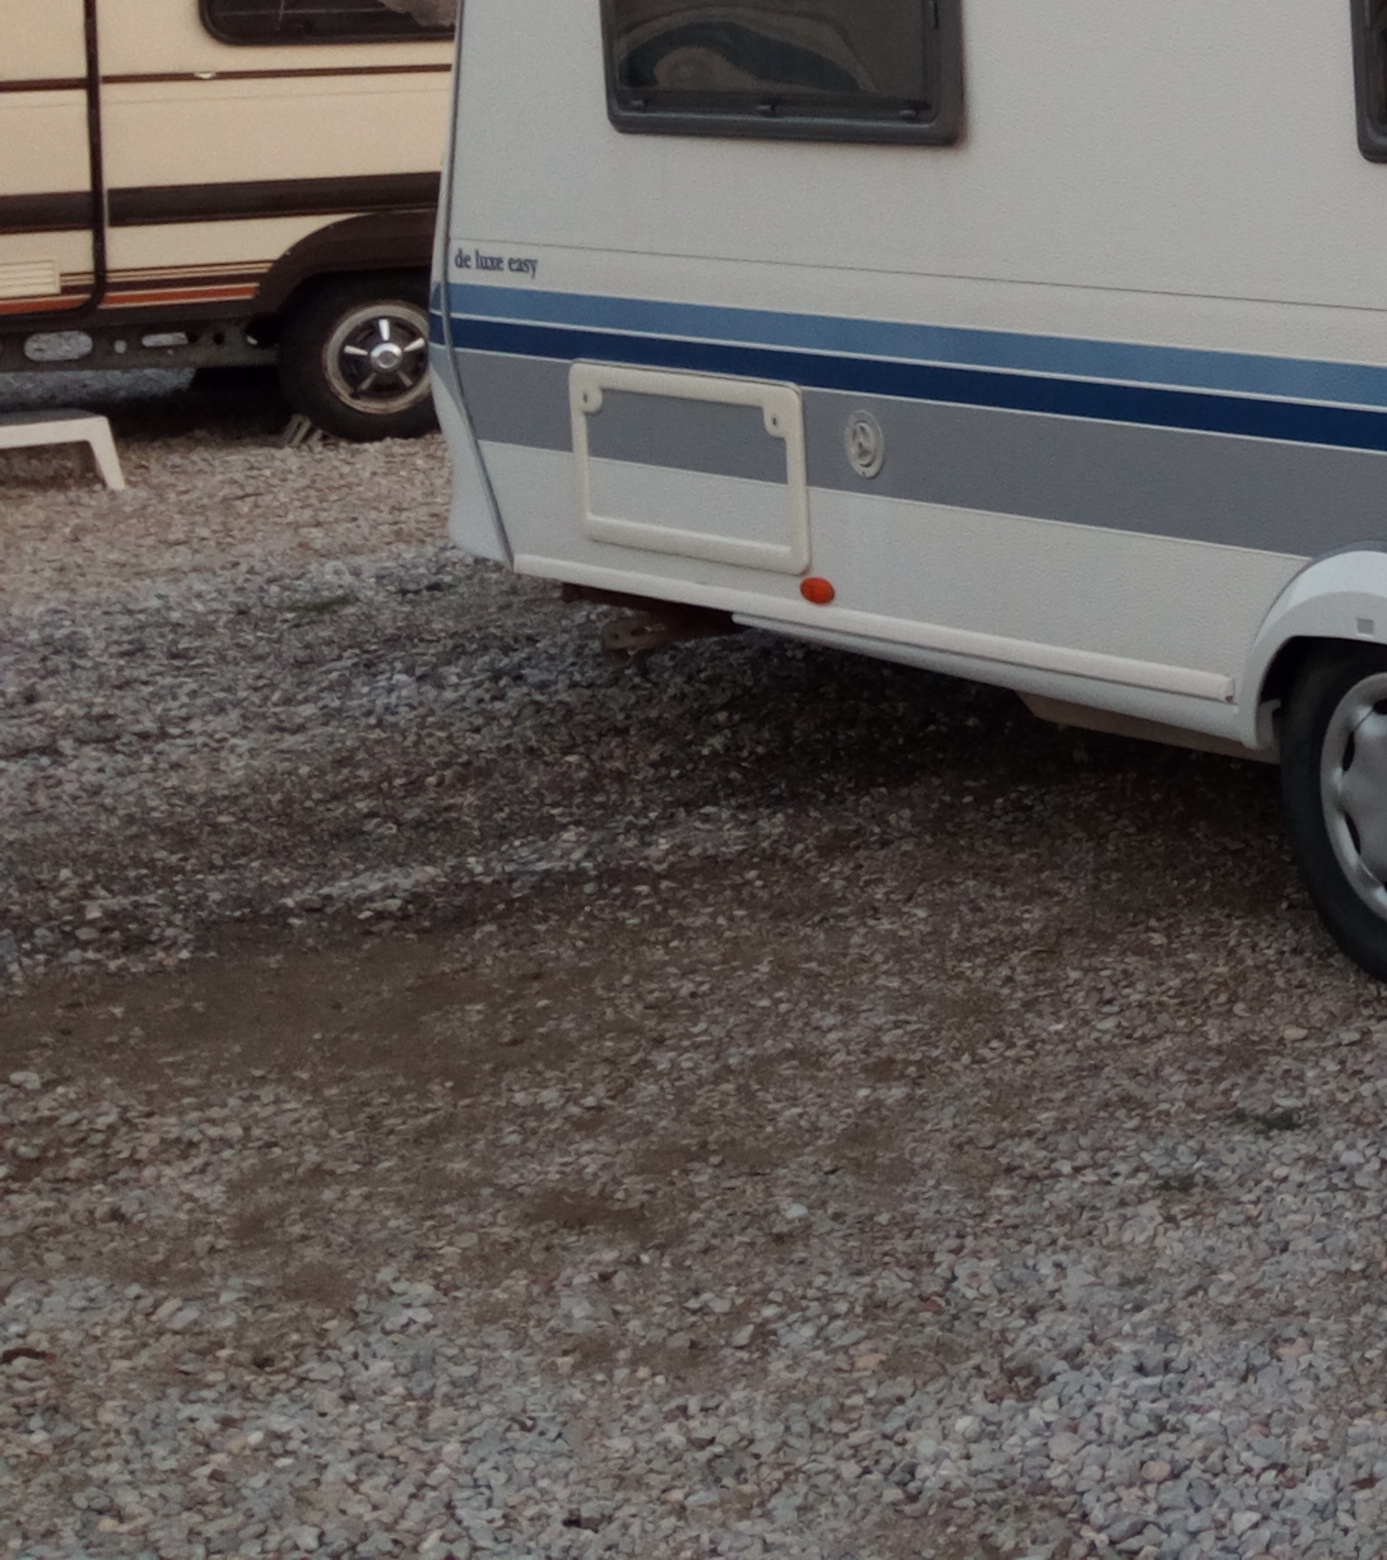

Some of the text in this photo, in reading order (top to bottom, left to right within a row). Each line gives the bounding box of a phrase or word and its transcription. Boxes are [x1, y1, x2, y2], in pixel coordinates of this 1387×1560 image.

[454, 248, 538, 280] de luxe easy
